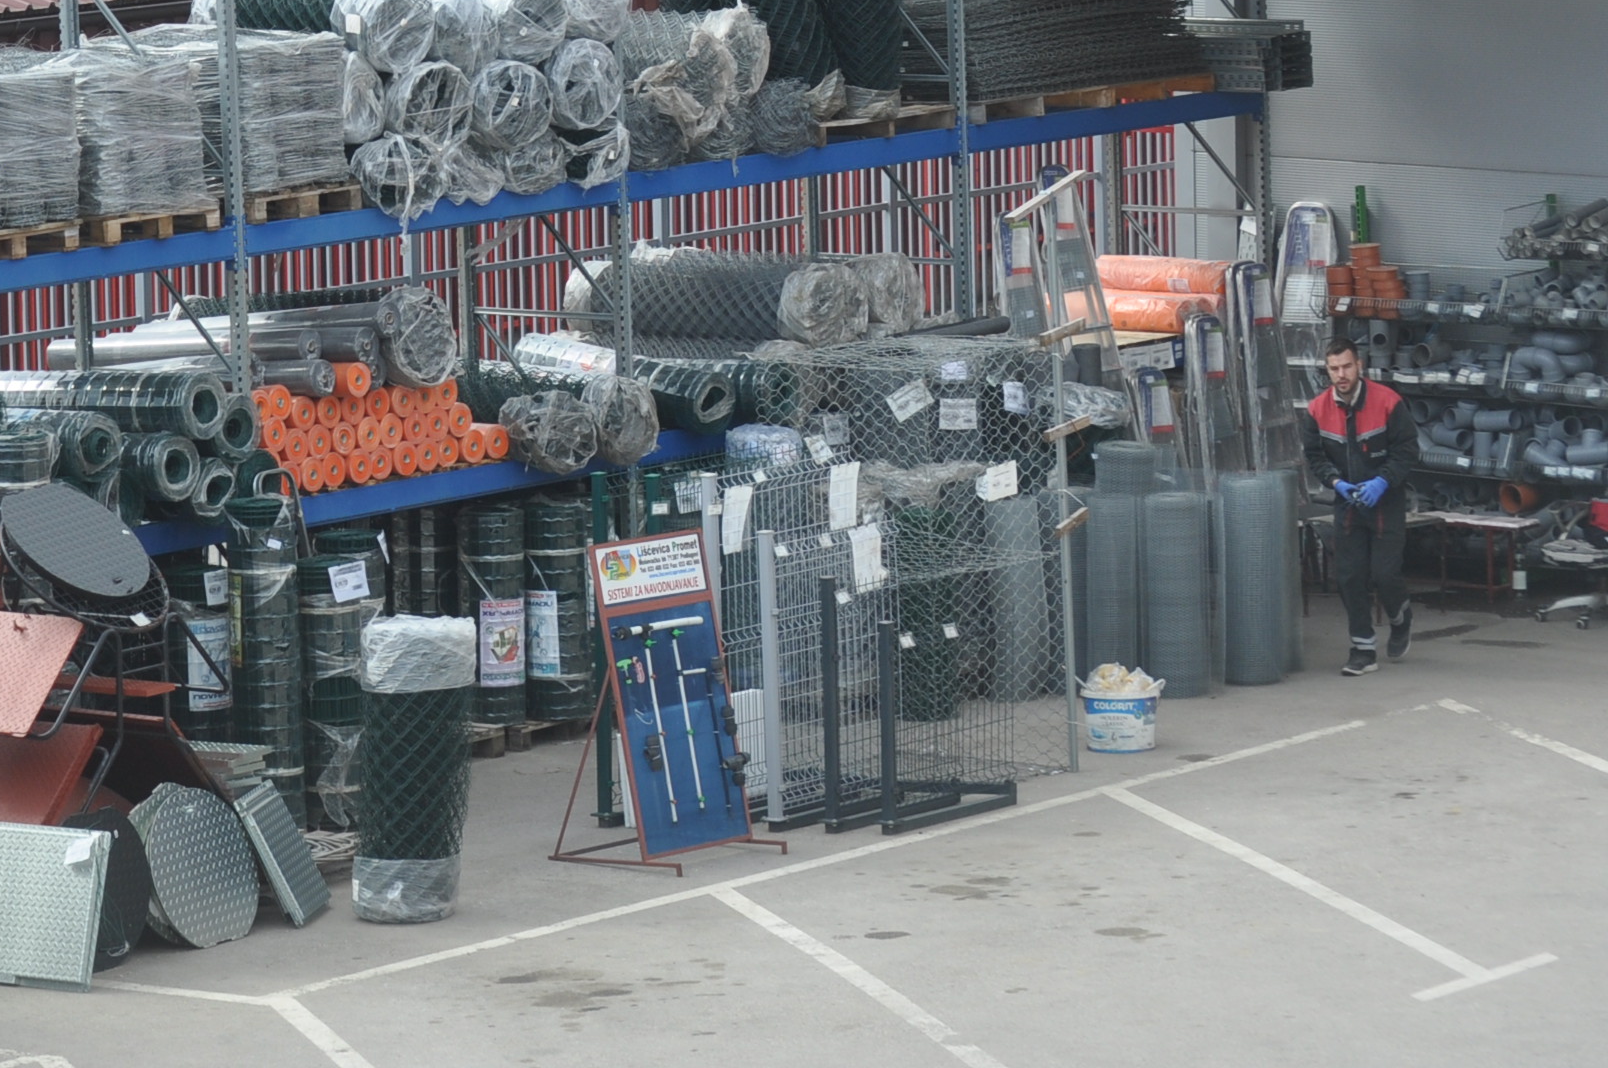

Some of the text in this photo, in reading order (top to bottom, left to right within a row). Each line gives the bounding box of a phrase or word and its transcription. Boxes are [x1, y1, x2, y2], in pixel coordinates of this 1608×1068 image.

[608, 576, 699, 601] SISTEMI ZA NAVODNJAVANJE
